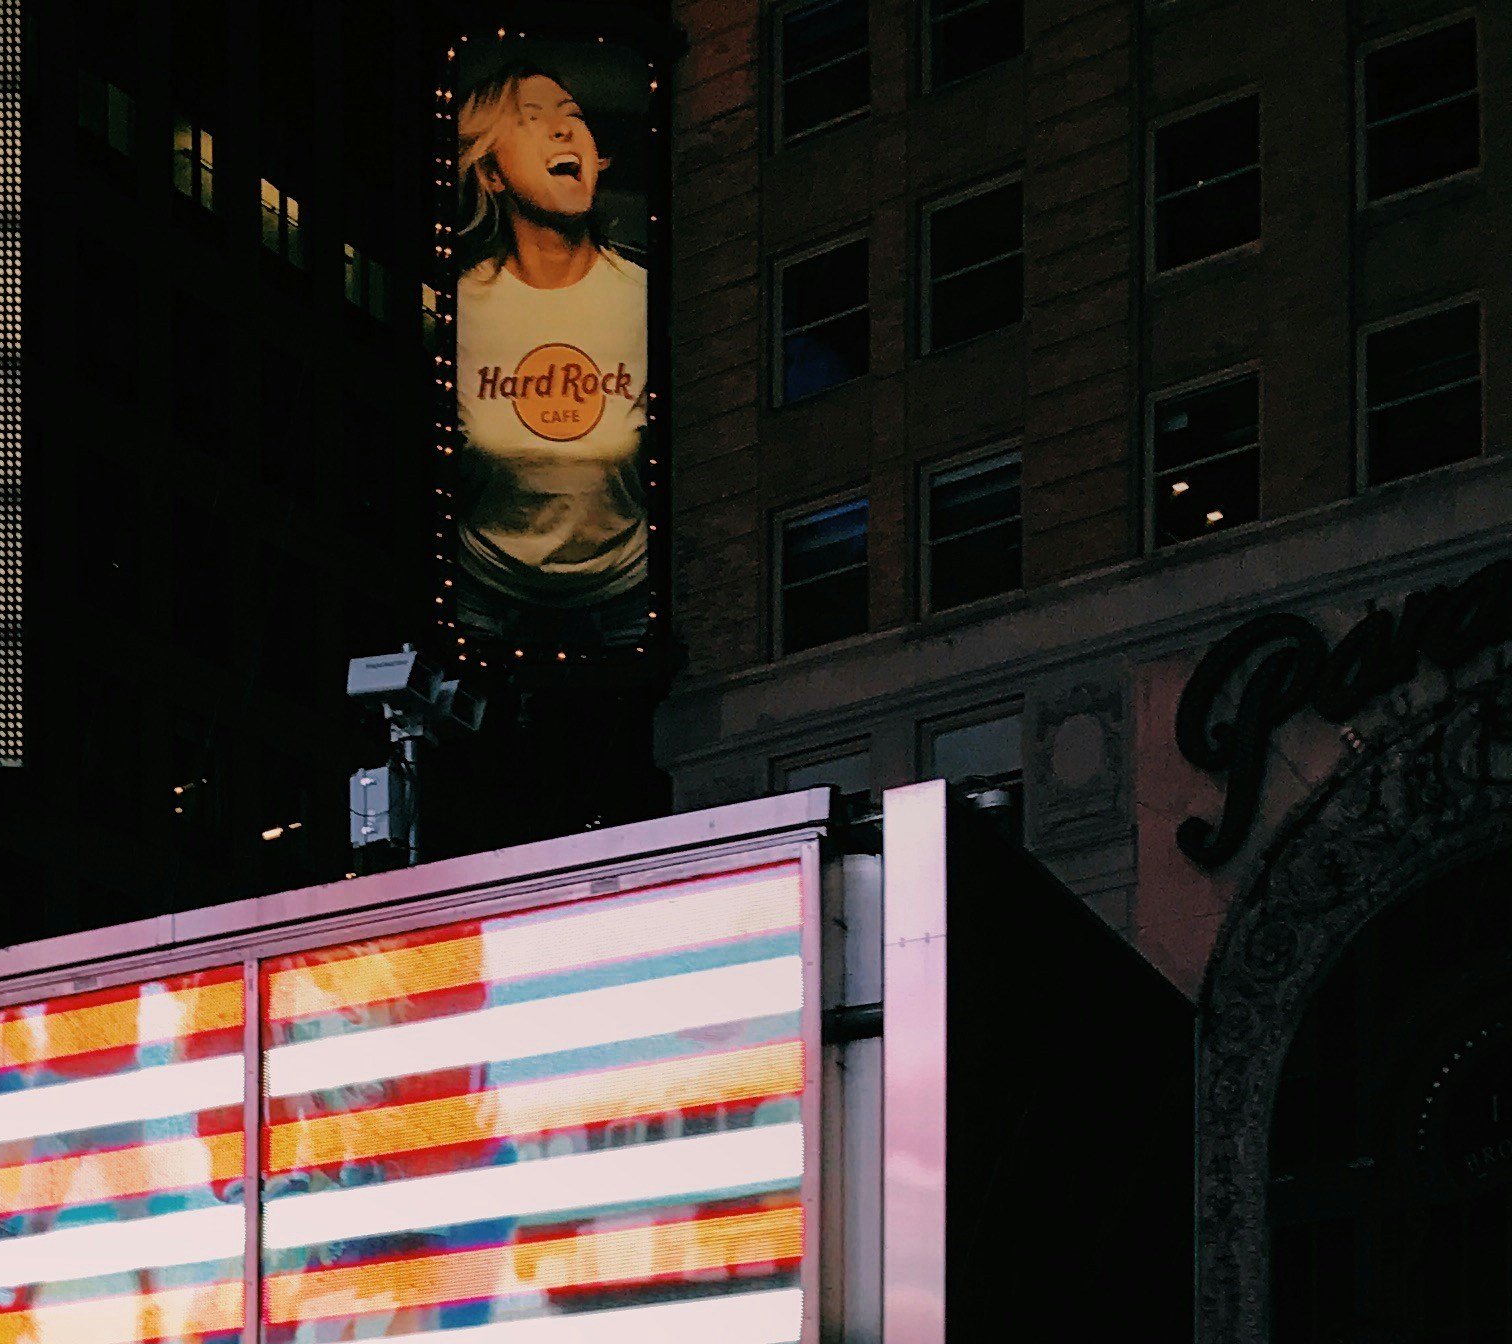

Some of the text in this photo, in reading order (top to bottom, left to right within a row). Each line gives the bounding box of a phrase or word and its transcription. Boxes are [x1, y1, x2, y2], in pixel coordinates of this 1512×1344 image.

[477, 362, 633, 404] Hard Rock
[540, 410, 581, 424] CAFE
